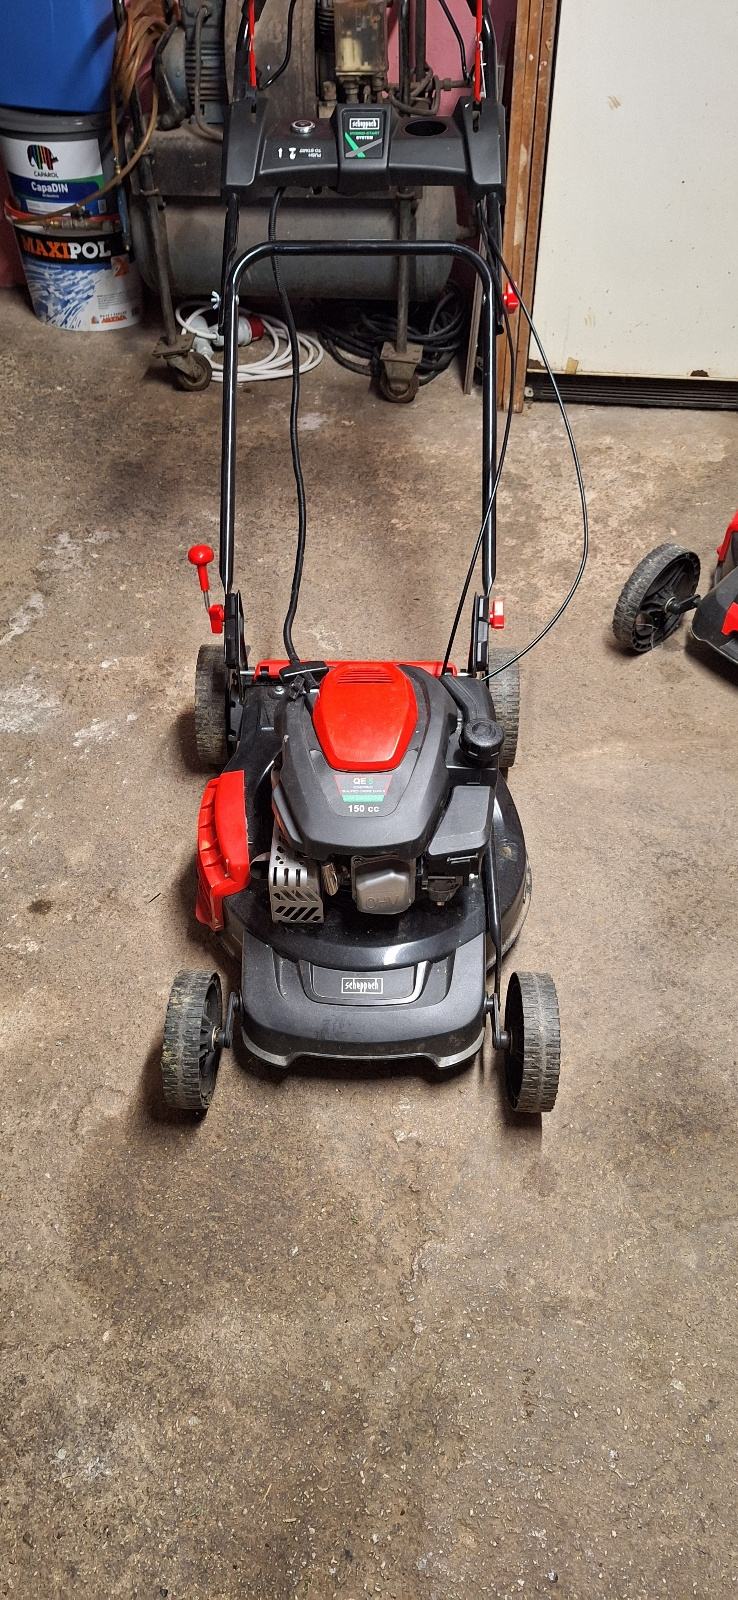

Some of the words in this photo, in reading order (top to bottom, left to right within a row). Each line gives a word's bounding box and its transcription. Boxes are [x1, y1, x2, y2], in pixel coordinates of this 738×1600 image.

[351, 119, 377, 129] scheppach
[31, 181, 69, 194] CapaDIN
[20, 236, 112, 260] MAXIPOL
[348, 804, 365, 813] 150
[344, 979, 379, 992] scheppach
